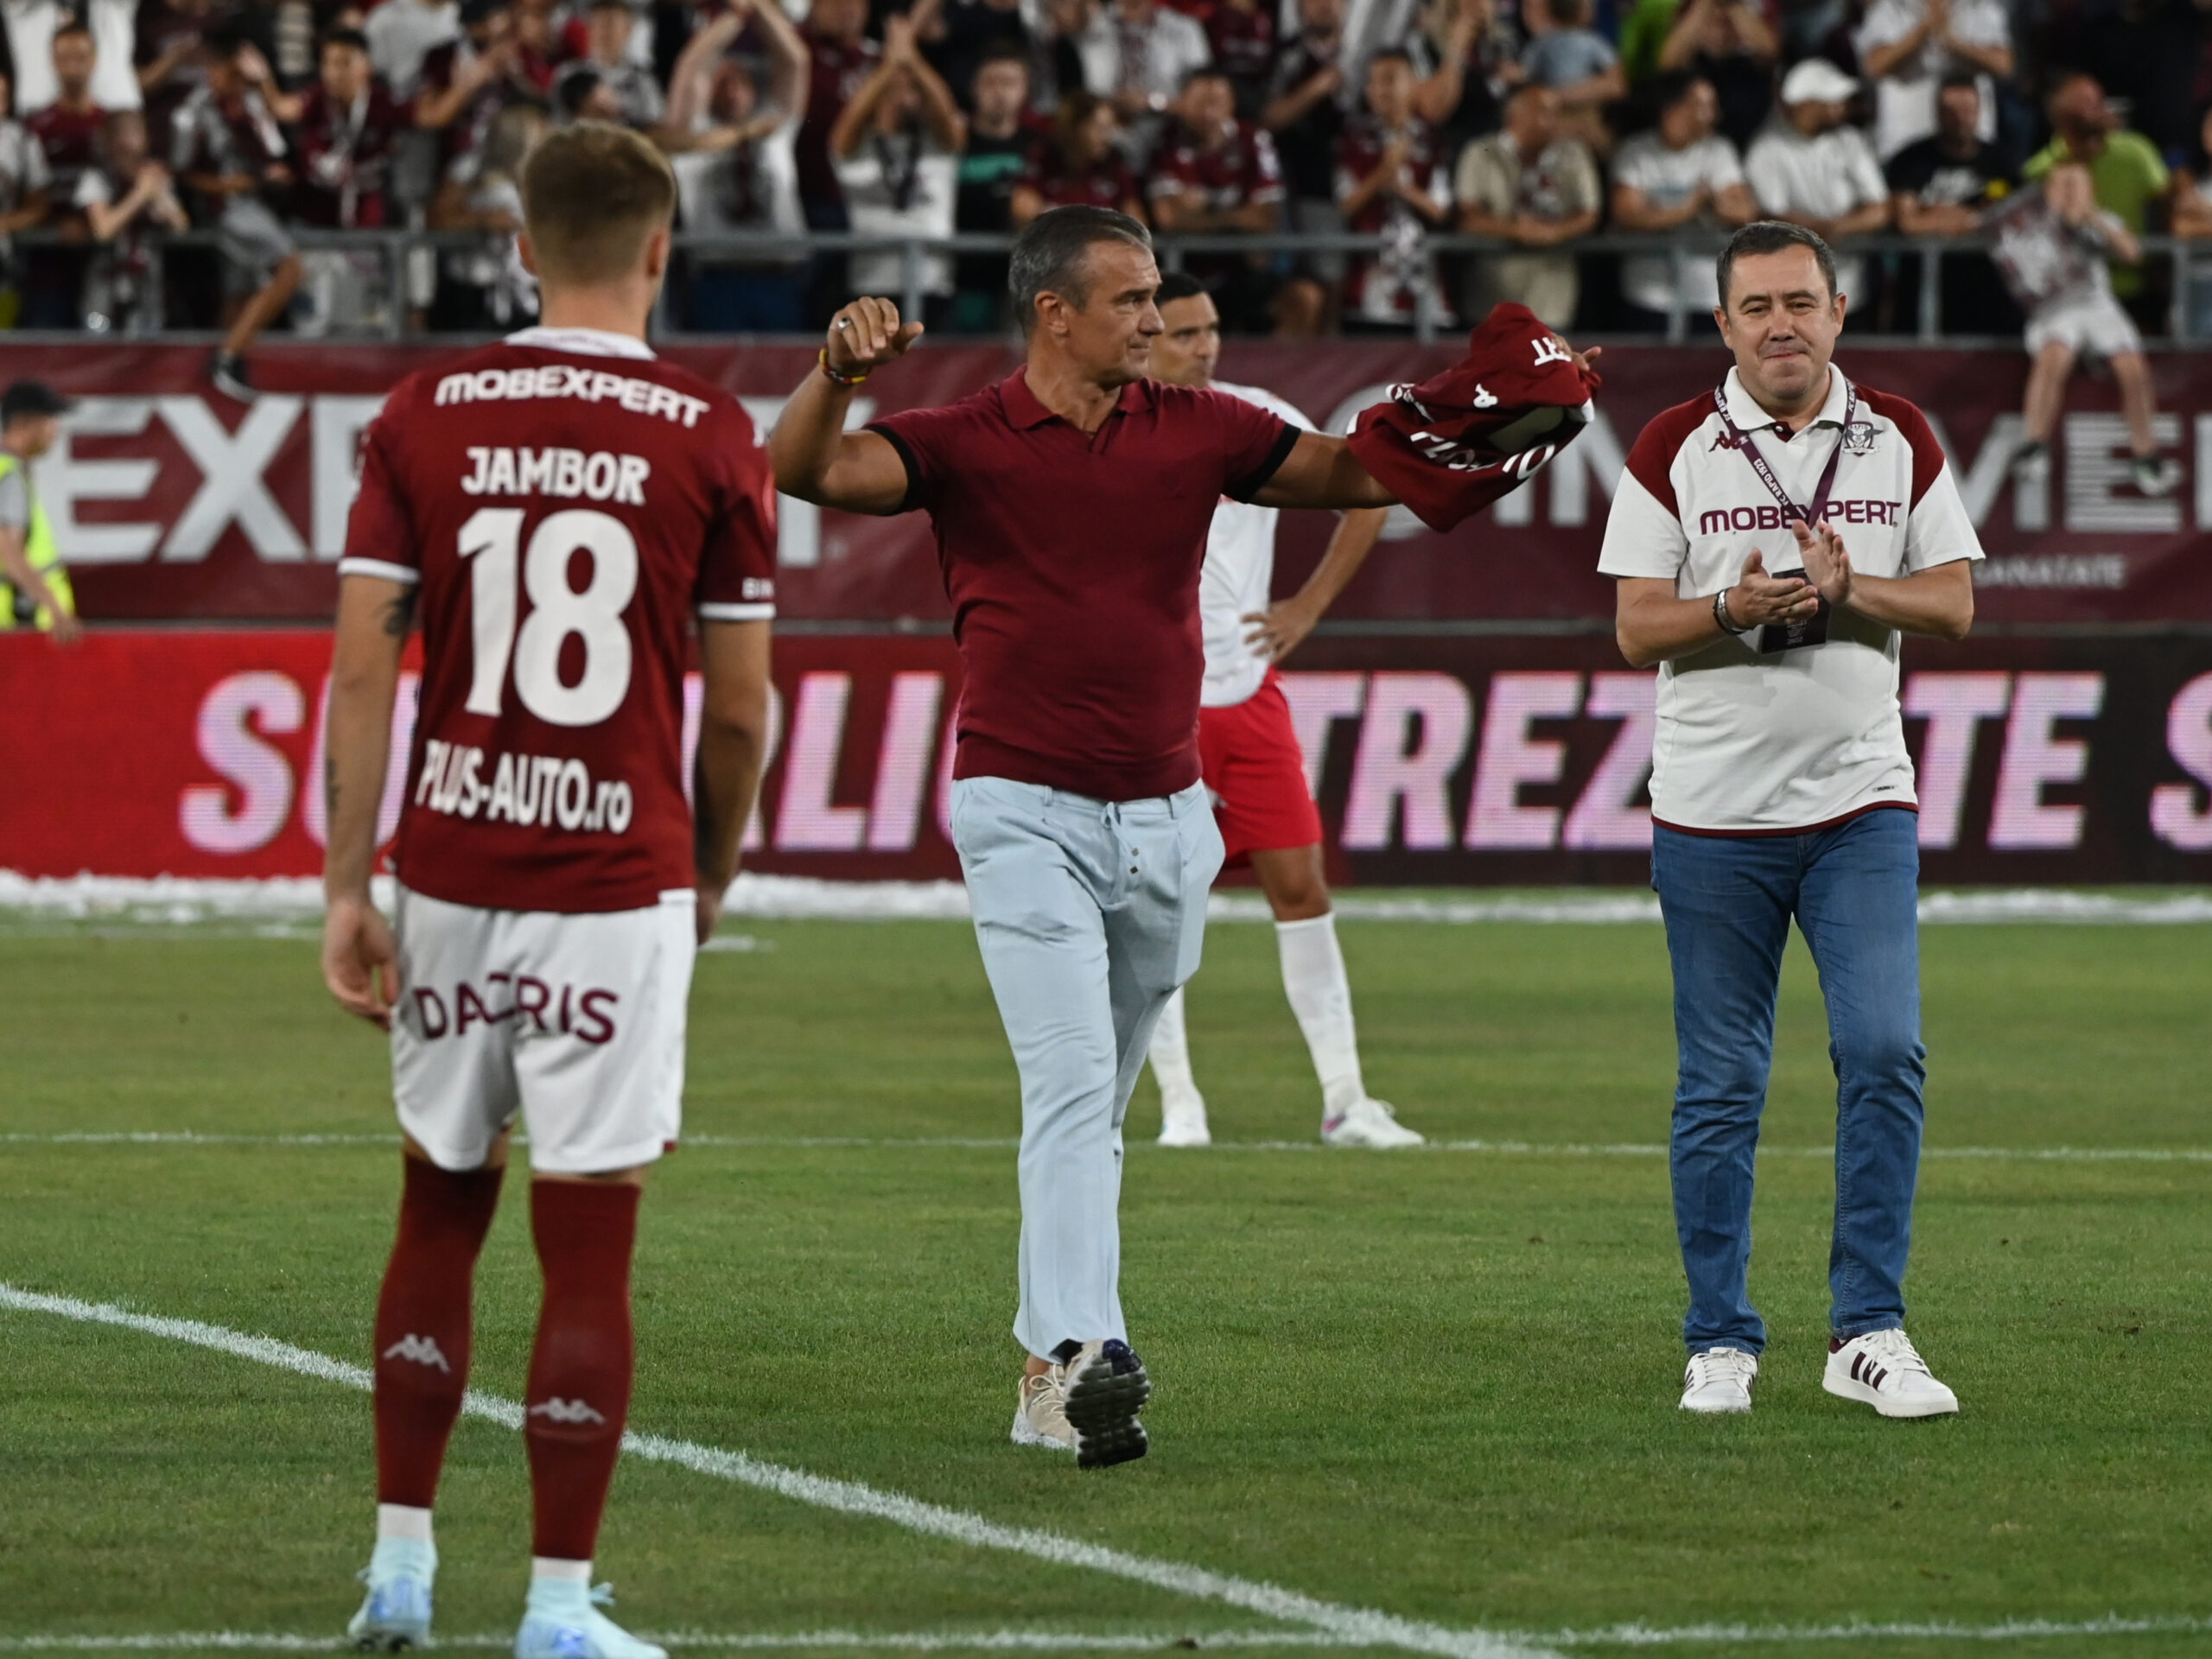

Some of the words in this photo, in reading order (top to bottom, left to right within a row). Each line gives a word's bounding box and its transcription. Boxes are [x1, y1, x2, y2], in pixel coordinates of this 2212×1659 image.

[435, 365, 711, 428] MOBEXPERT
[461, 446, 651, 505] JAMBOR
[1700, 499, 1903, 535] MOBEPERT
[457, 507, 639, 728] 18
